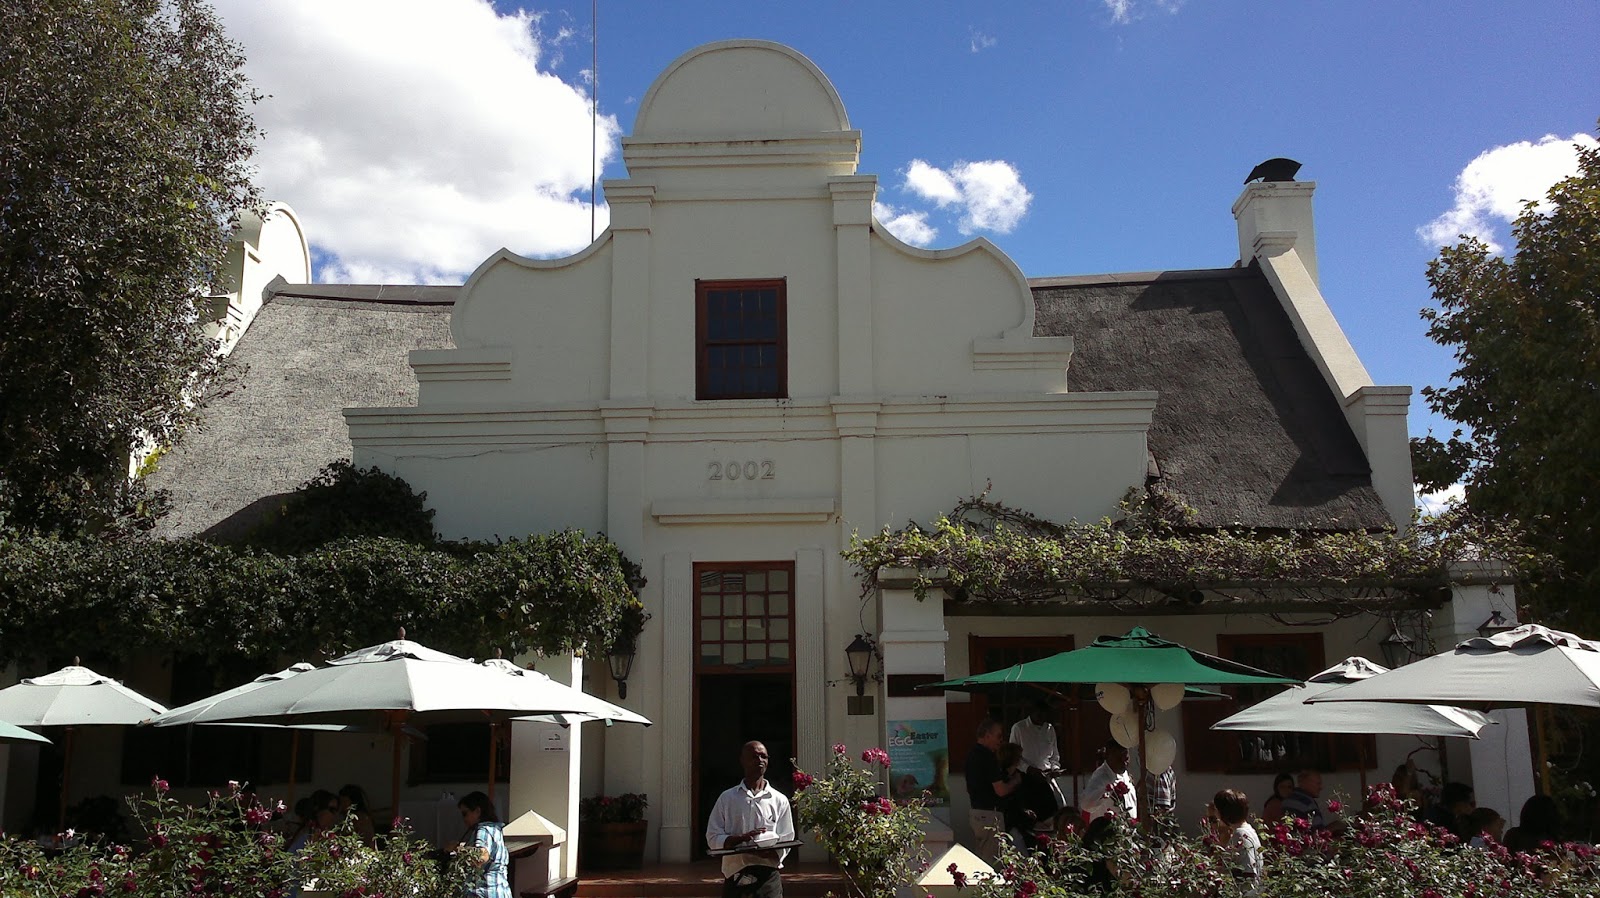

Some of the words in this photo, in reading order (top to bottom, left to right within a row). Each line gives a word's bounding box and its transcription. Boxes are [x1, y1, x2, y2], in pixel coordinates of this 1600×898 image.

[708, 460, 775, 480] 2002
[910, 731, 938, 740] Easter
[889, 736, 914, 746] EGG
